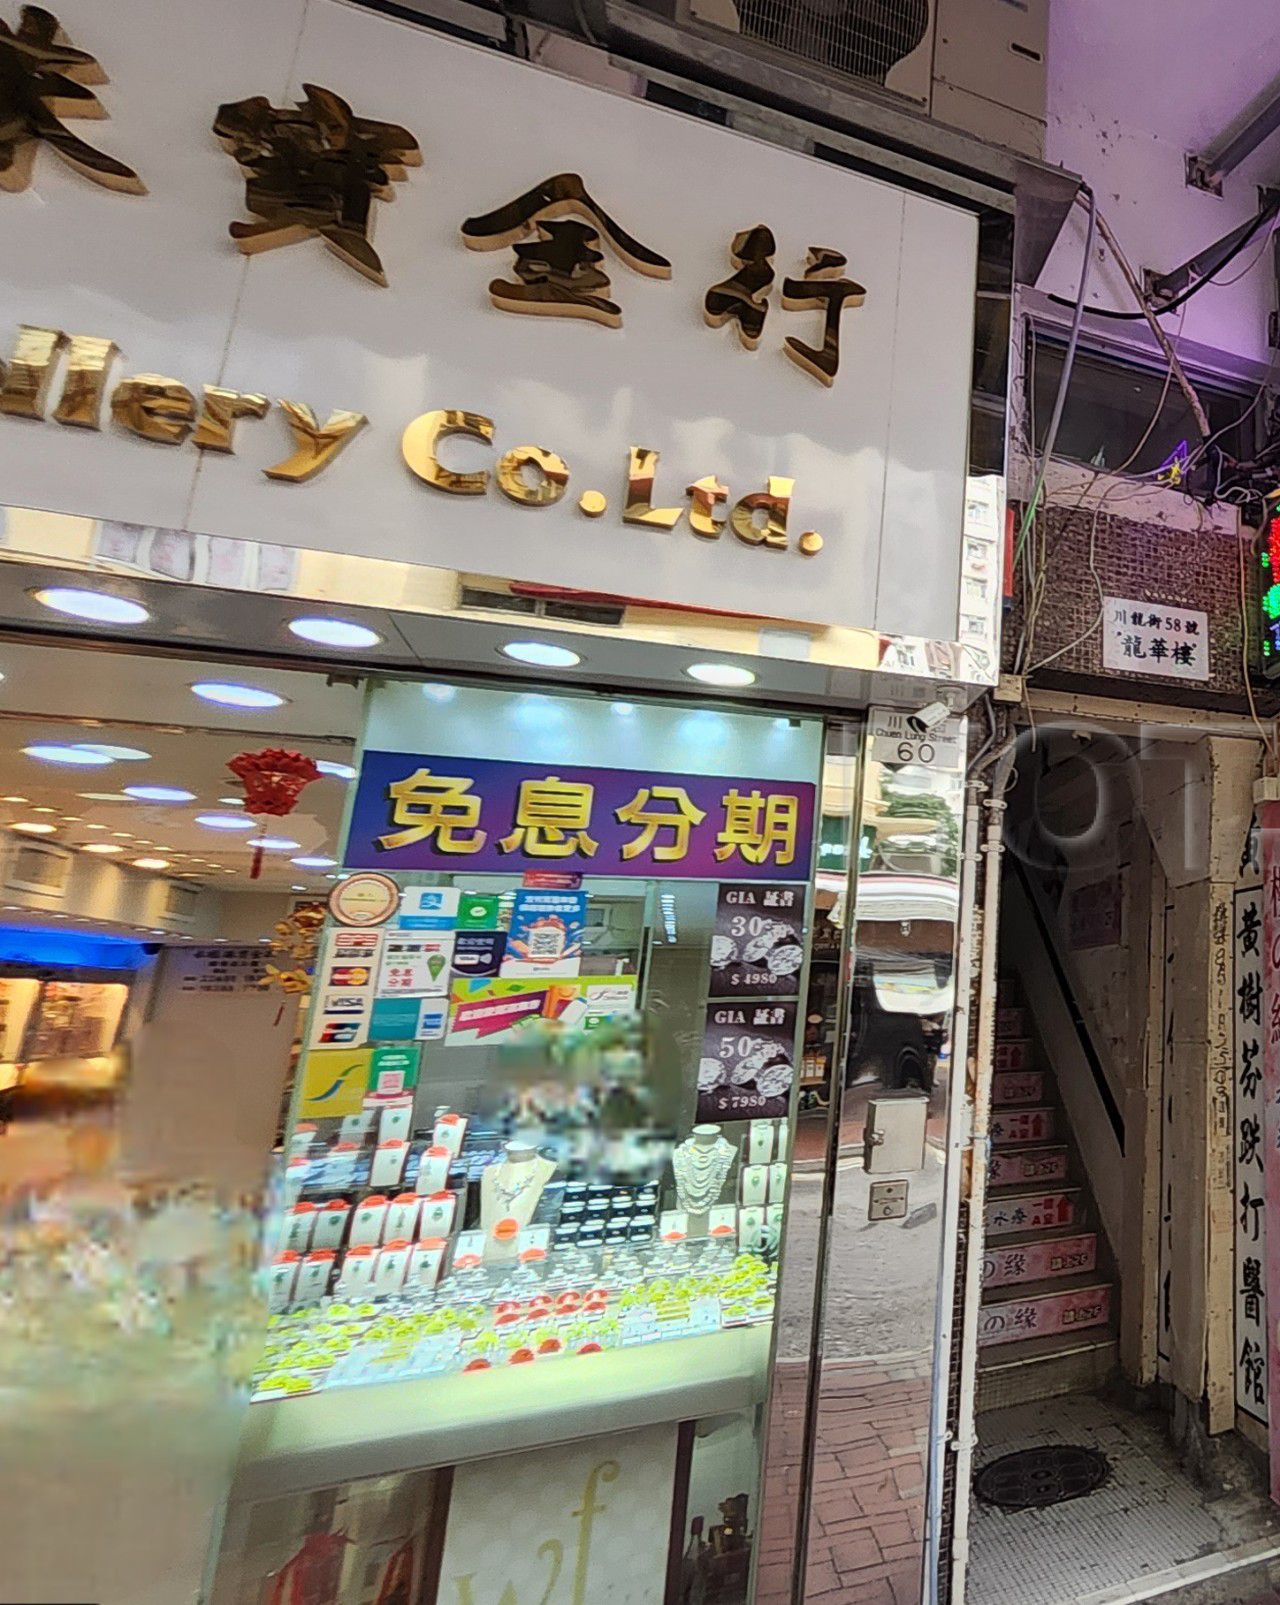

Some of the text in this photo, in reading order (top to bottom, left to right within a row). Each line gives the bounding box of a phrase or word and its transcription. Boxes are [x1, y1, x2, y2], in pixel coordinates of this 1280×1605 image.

[0, 322, 370, 484] llery
[1121, 635, 1196, 666] 龍華樓
[897, 741, 935, 763] 60
[377, 767, 800, 866] 免息分期
[726, 890, 756, 905] GIA
[714, 1010, 745, 1025] GIA
